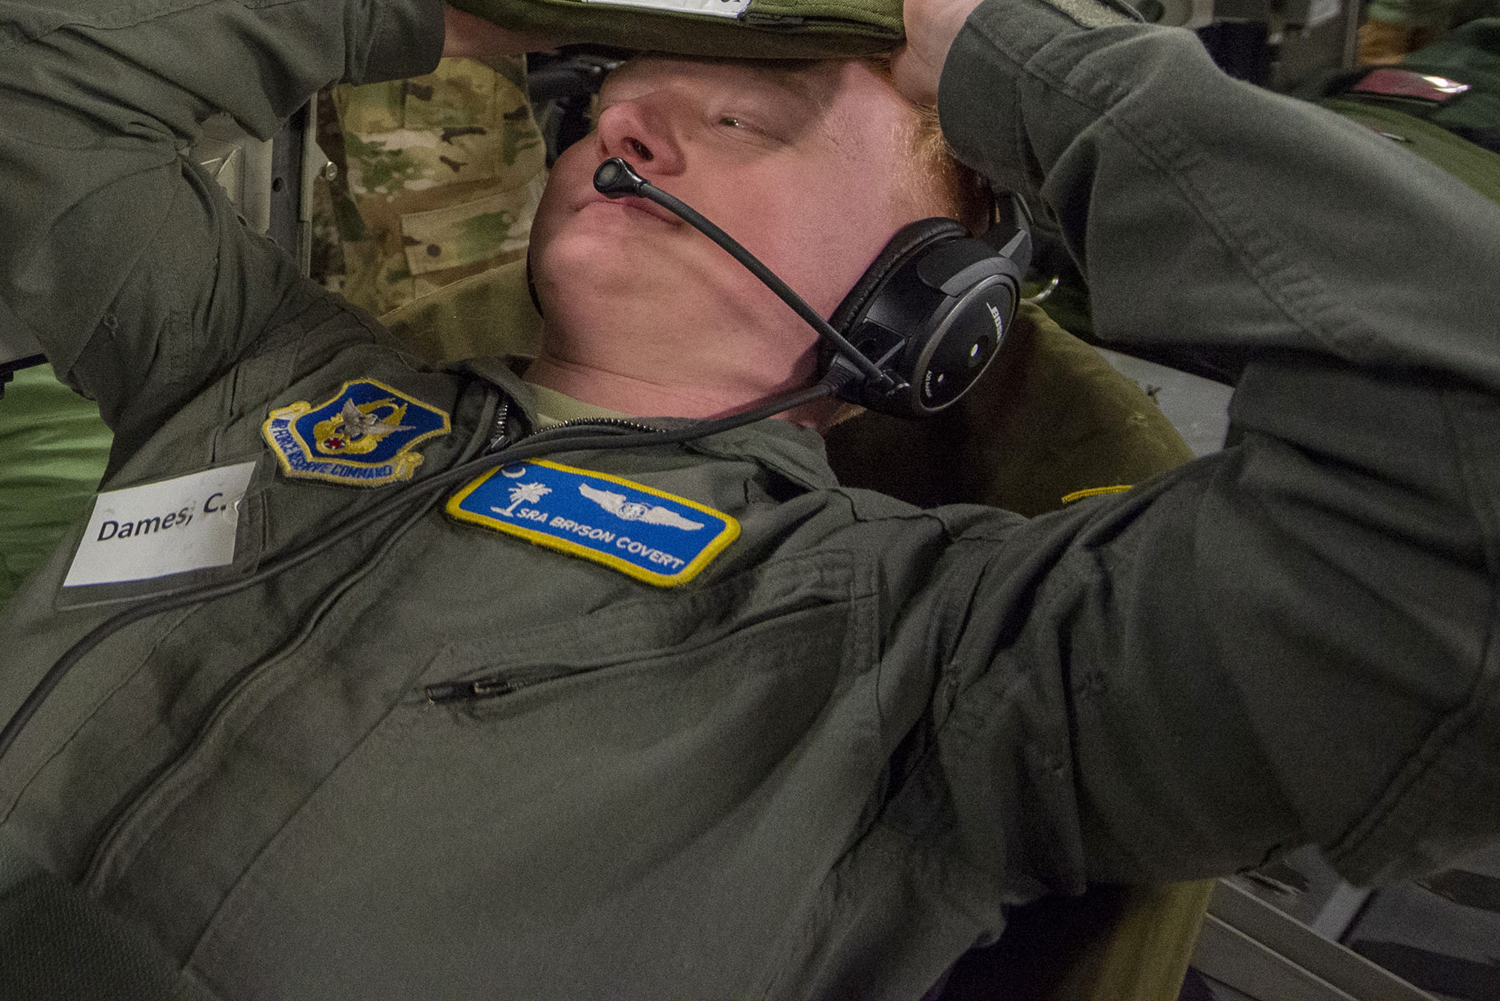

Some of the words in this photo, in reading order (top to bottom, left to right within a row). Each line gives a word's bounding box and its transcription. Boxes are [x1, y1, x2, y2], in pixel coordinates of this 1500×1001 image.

[330, 464, 393, 479] COMMAND
[97, 506, 194, 542] Dames,
[203, 492, 226, 514] C.
[516, 507, 549, 523] SRA
[549, 515, 616, 543] BRYSON
[615, 536, 685, 570] COVERT
